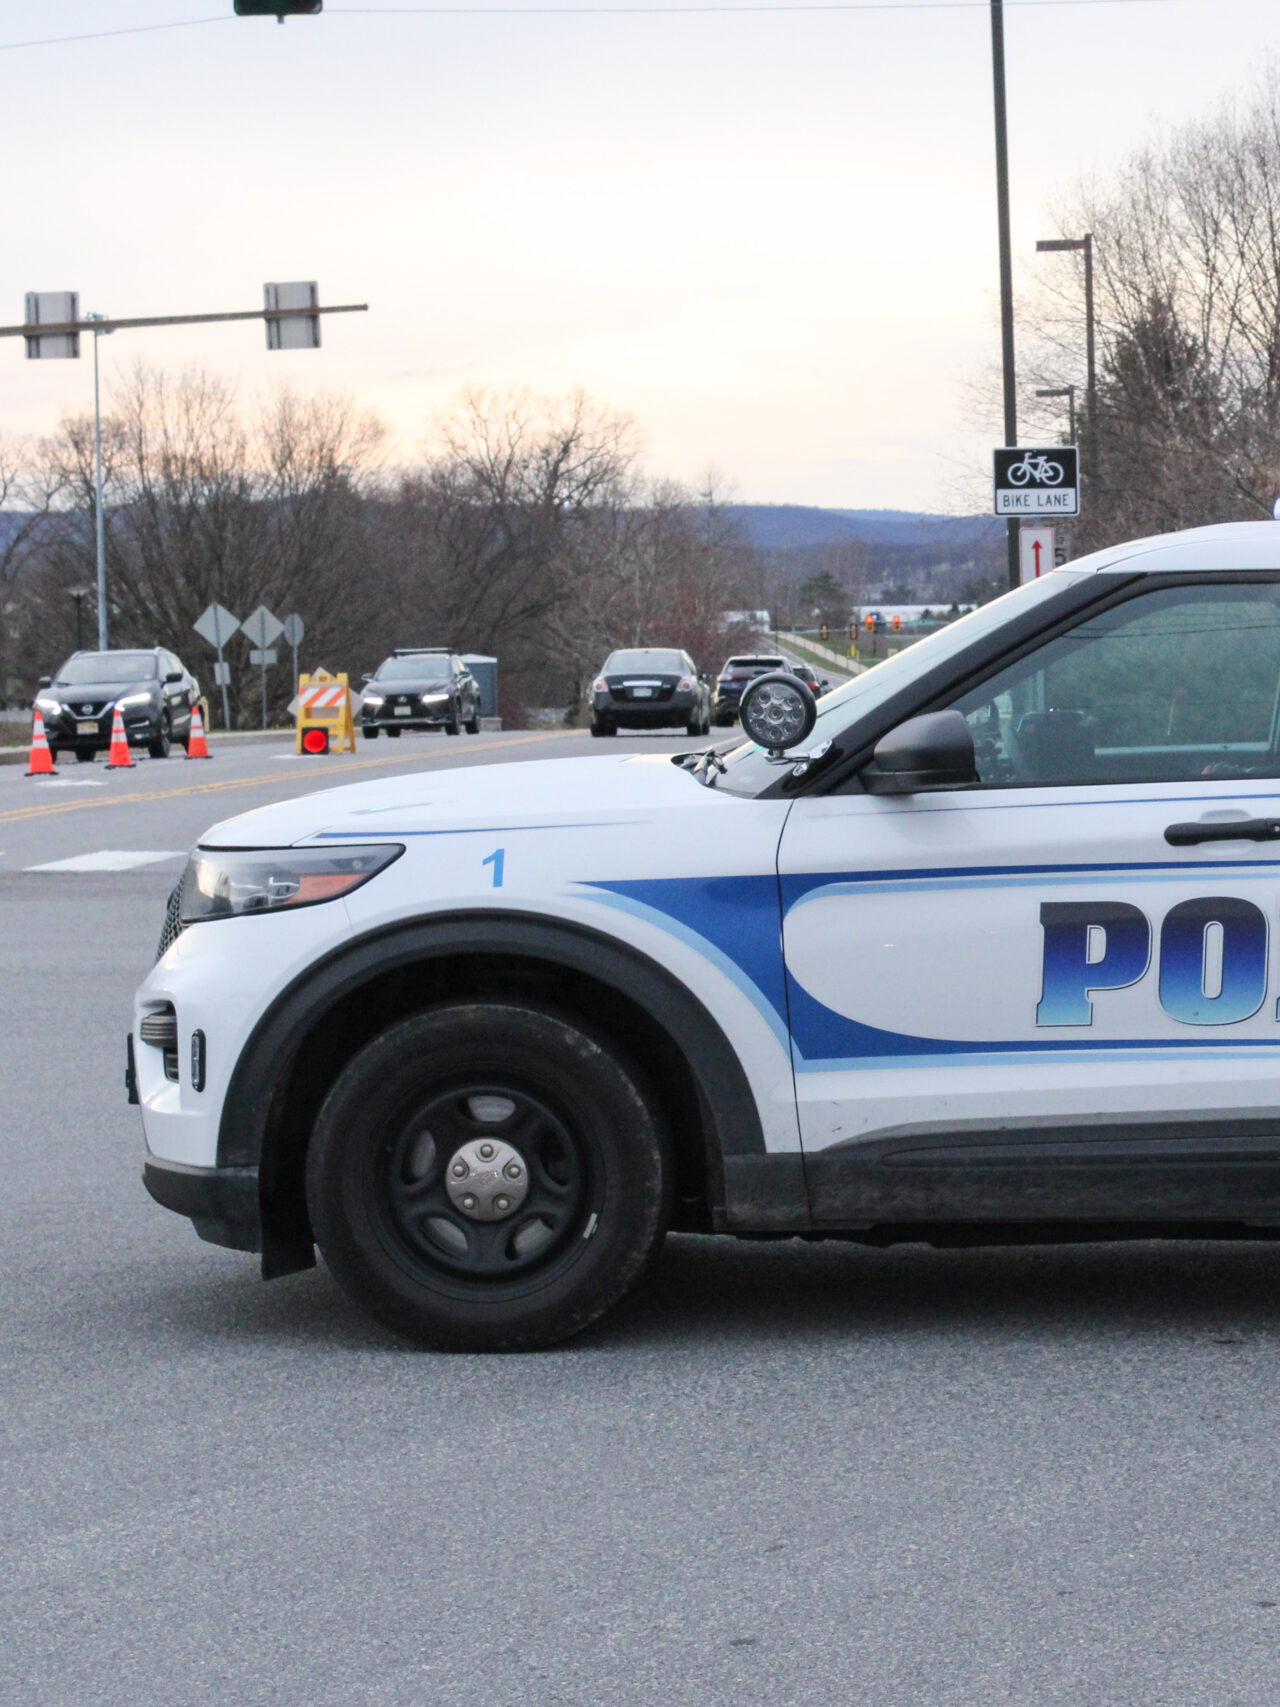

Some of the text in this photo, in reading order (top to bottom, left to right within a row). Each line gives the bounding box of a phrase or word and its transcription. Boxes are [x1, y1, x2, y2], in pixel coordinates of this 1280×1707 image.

[1003, 493, 1069, 507] BIKE LANE
[482, 848, 505, 887] 1
